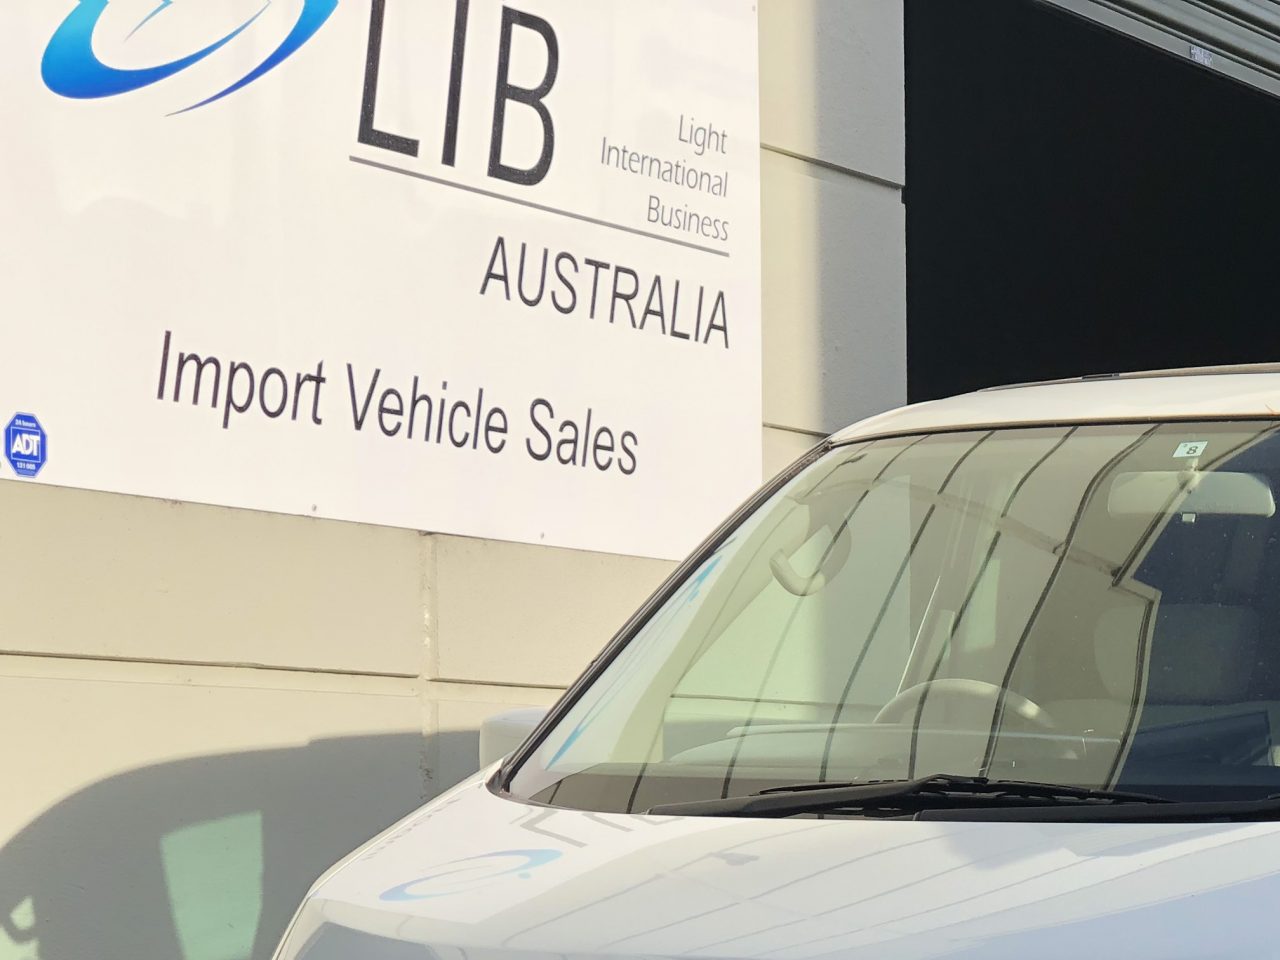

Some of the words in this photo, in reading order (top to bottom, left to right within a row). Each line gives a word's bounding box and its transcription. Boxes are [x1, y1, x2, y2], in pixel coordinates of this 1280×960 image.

[357, 0, 559, 186] LIB
[677, 114, 728, 156] Light
[600, 136, 728, 197] International
[646, 195, 730, 241] Business
[479, 236, 730, 349] AUSTRALIA
[156, 330, 327, 429] Import
[346, 362, 509, 454] Vehicle
[525, 398, 639, 475] Sales
[12, 433, 40, 456] ADT
